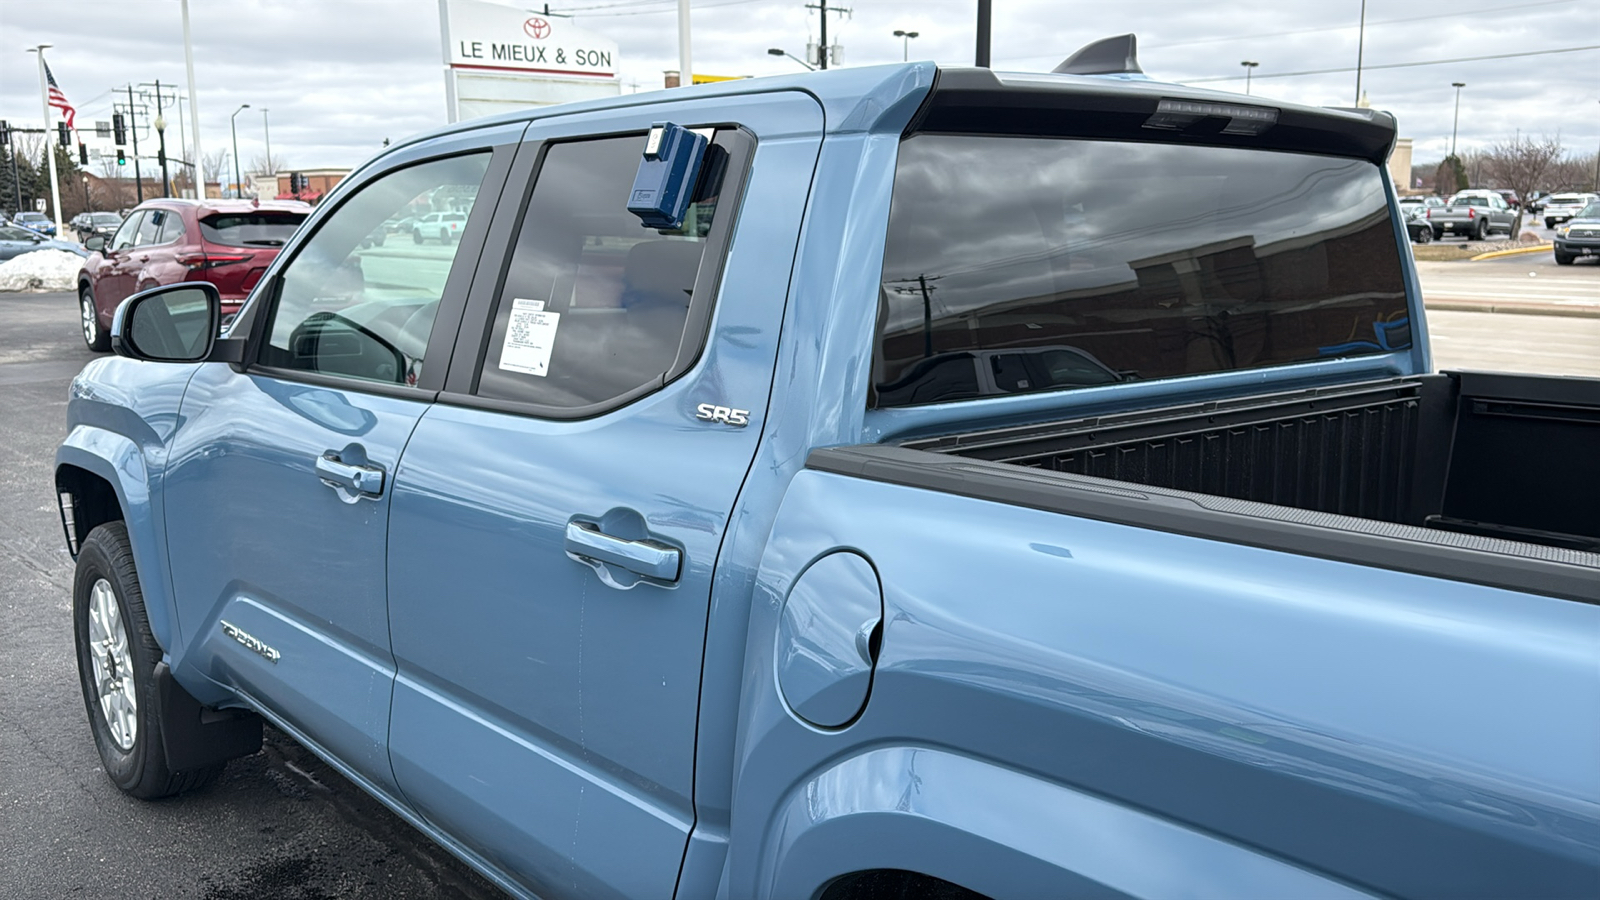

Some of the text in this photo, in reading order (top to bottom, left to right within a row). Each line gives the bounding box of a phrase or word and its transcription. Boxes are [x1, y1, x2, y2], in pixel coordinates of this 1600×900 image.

[461, 41, 612, 67] LE MIEUX & SON
[695, 402, 751, 427] SR5
[220, 619, 281, 664] TACOMA
